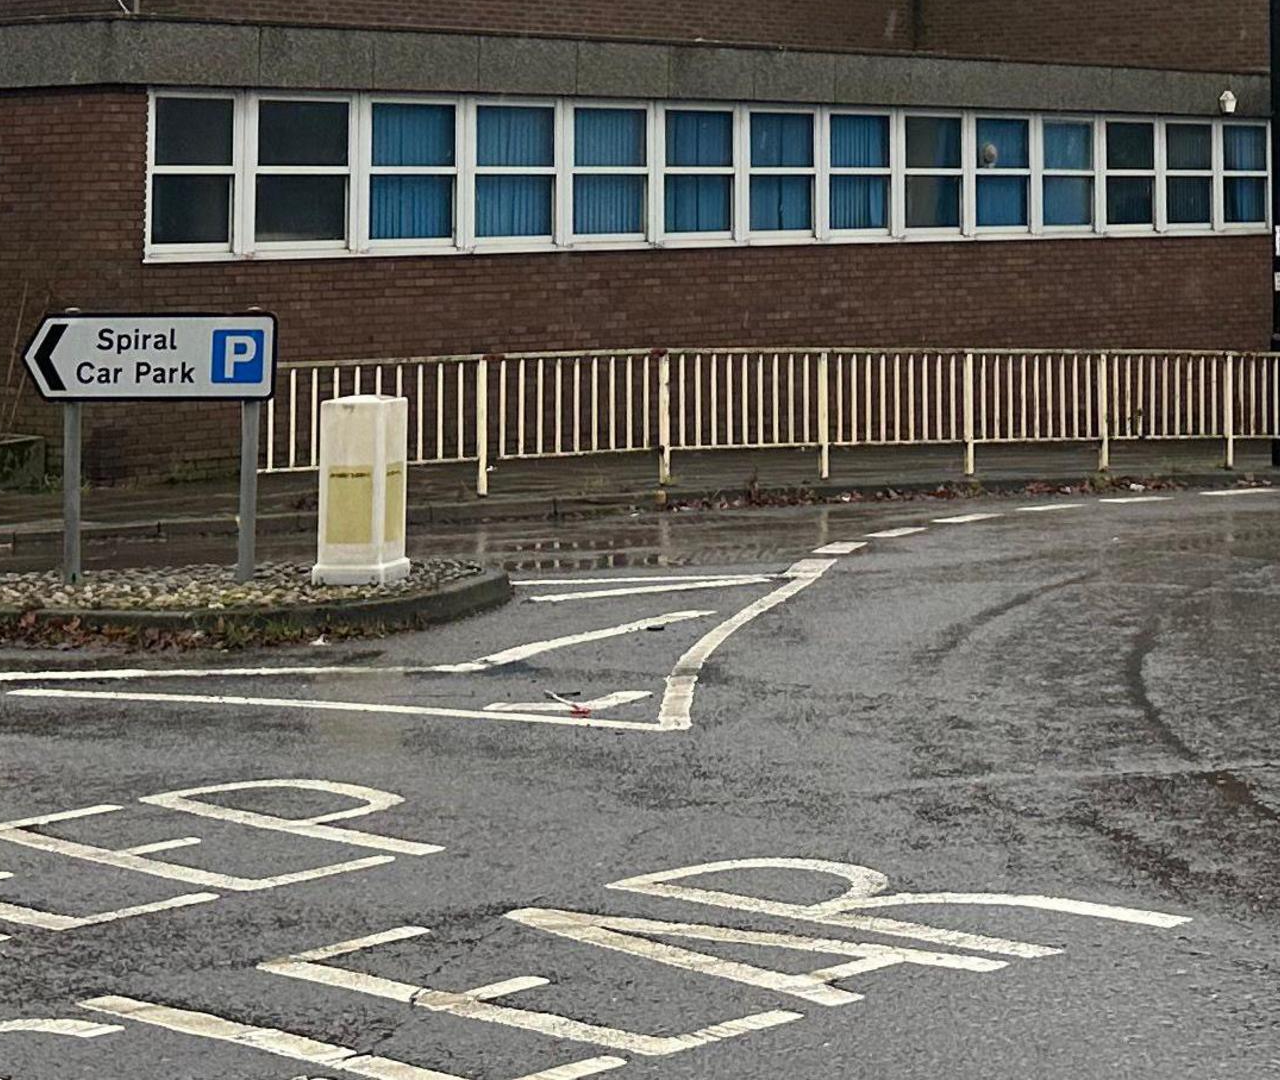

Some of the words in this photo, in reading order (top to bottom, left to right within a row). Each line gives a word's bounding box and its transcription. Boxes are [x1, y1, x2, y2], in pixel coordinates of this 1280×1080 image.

[96, 328, 178, 354] Spiral
[224, 335, 257, 379] P
[76, 361, 123, 384] Car
[135, 361, 195, 384] Park
